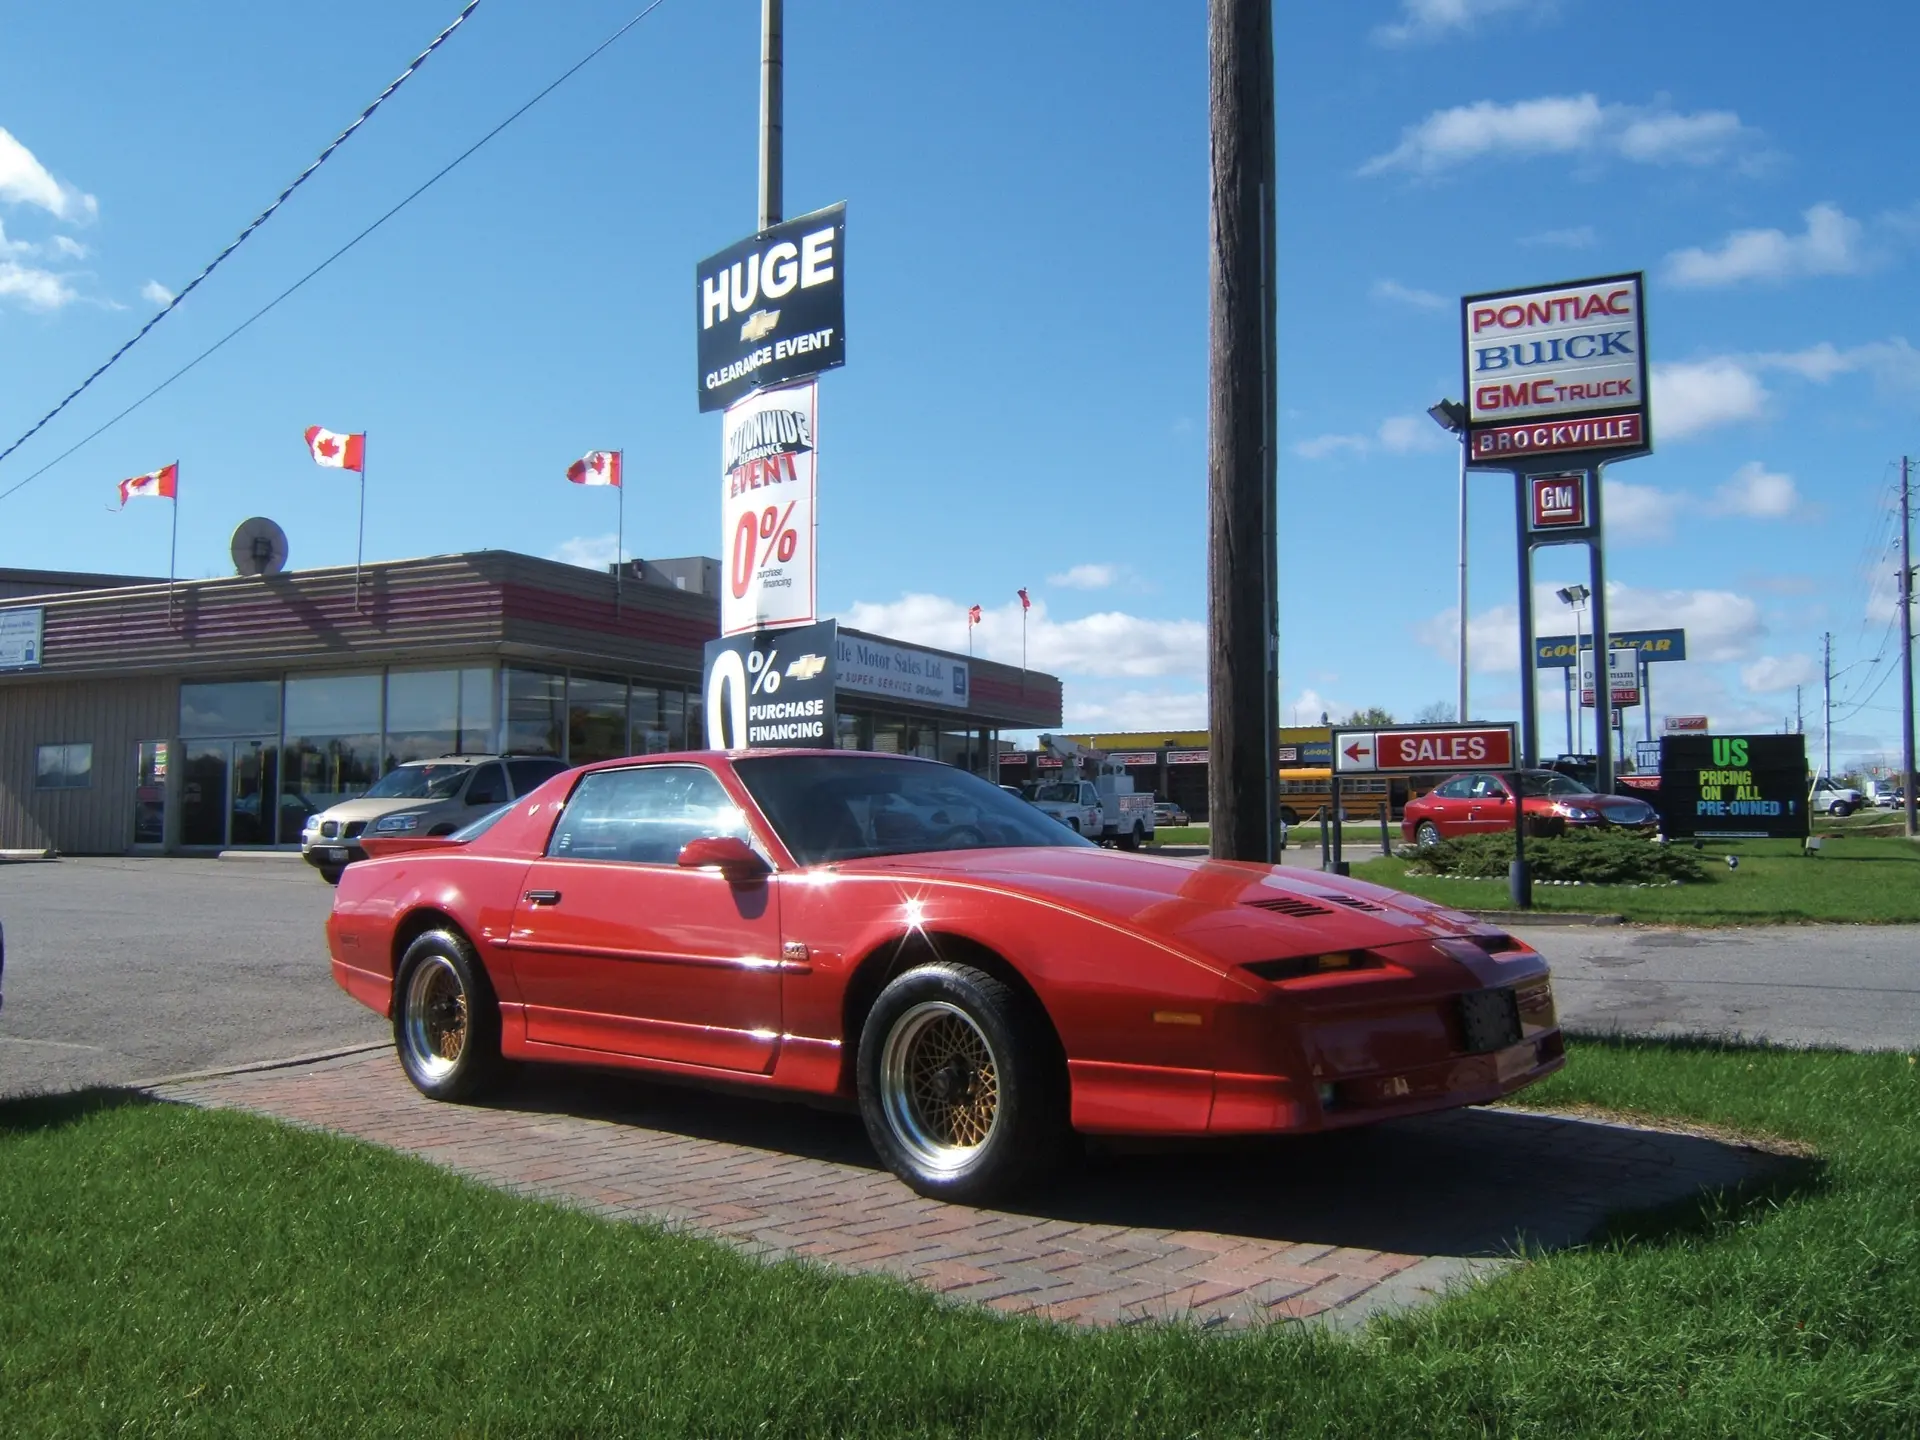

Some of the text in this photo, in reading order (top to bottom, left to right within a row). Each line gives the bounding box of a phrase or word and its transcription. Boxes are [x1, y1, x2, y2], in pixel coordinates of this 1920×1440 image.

[703, 227, 835, 329] HUGE
[1474, 290, 1629, 333] PONTIAC
[706, 328, 834, 390] CLEARANCE EVENT
[1475, 330, 1634, 371] BUICK
[1476, 379, 1633, 410] GMC TRUCK
[1480, 420, 1632, 451] BROCKVILLE
[739, 443, 784, 465] CLEARANCE
[731, 451, 798, 498] EVENT
[1541, 486, 1572, 509] GM
[731, 500, 798, 600] 0%
[763, 577, 793, 589] financing
[857, 644, 890, 670] Motor
[894, 653, 922, 675] Sales
[845, 672, 874, 685] SUPER
[878, 678, 912, 693] SERVICE
[707, 649, 781, 749] 0%
[749, 700, 824, 720] PURCHASE
[749, 721, 824, 741] FINANCING
[1400, 737, 1486, 762] SALES
[1712, 738, 1749, 767] US
[1699, 771, 1752, 786] PRICING
[1702, 786, 1762, 800] ON ALL
[1696, 801, 1781, 816] PRE-OWNED
